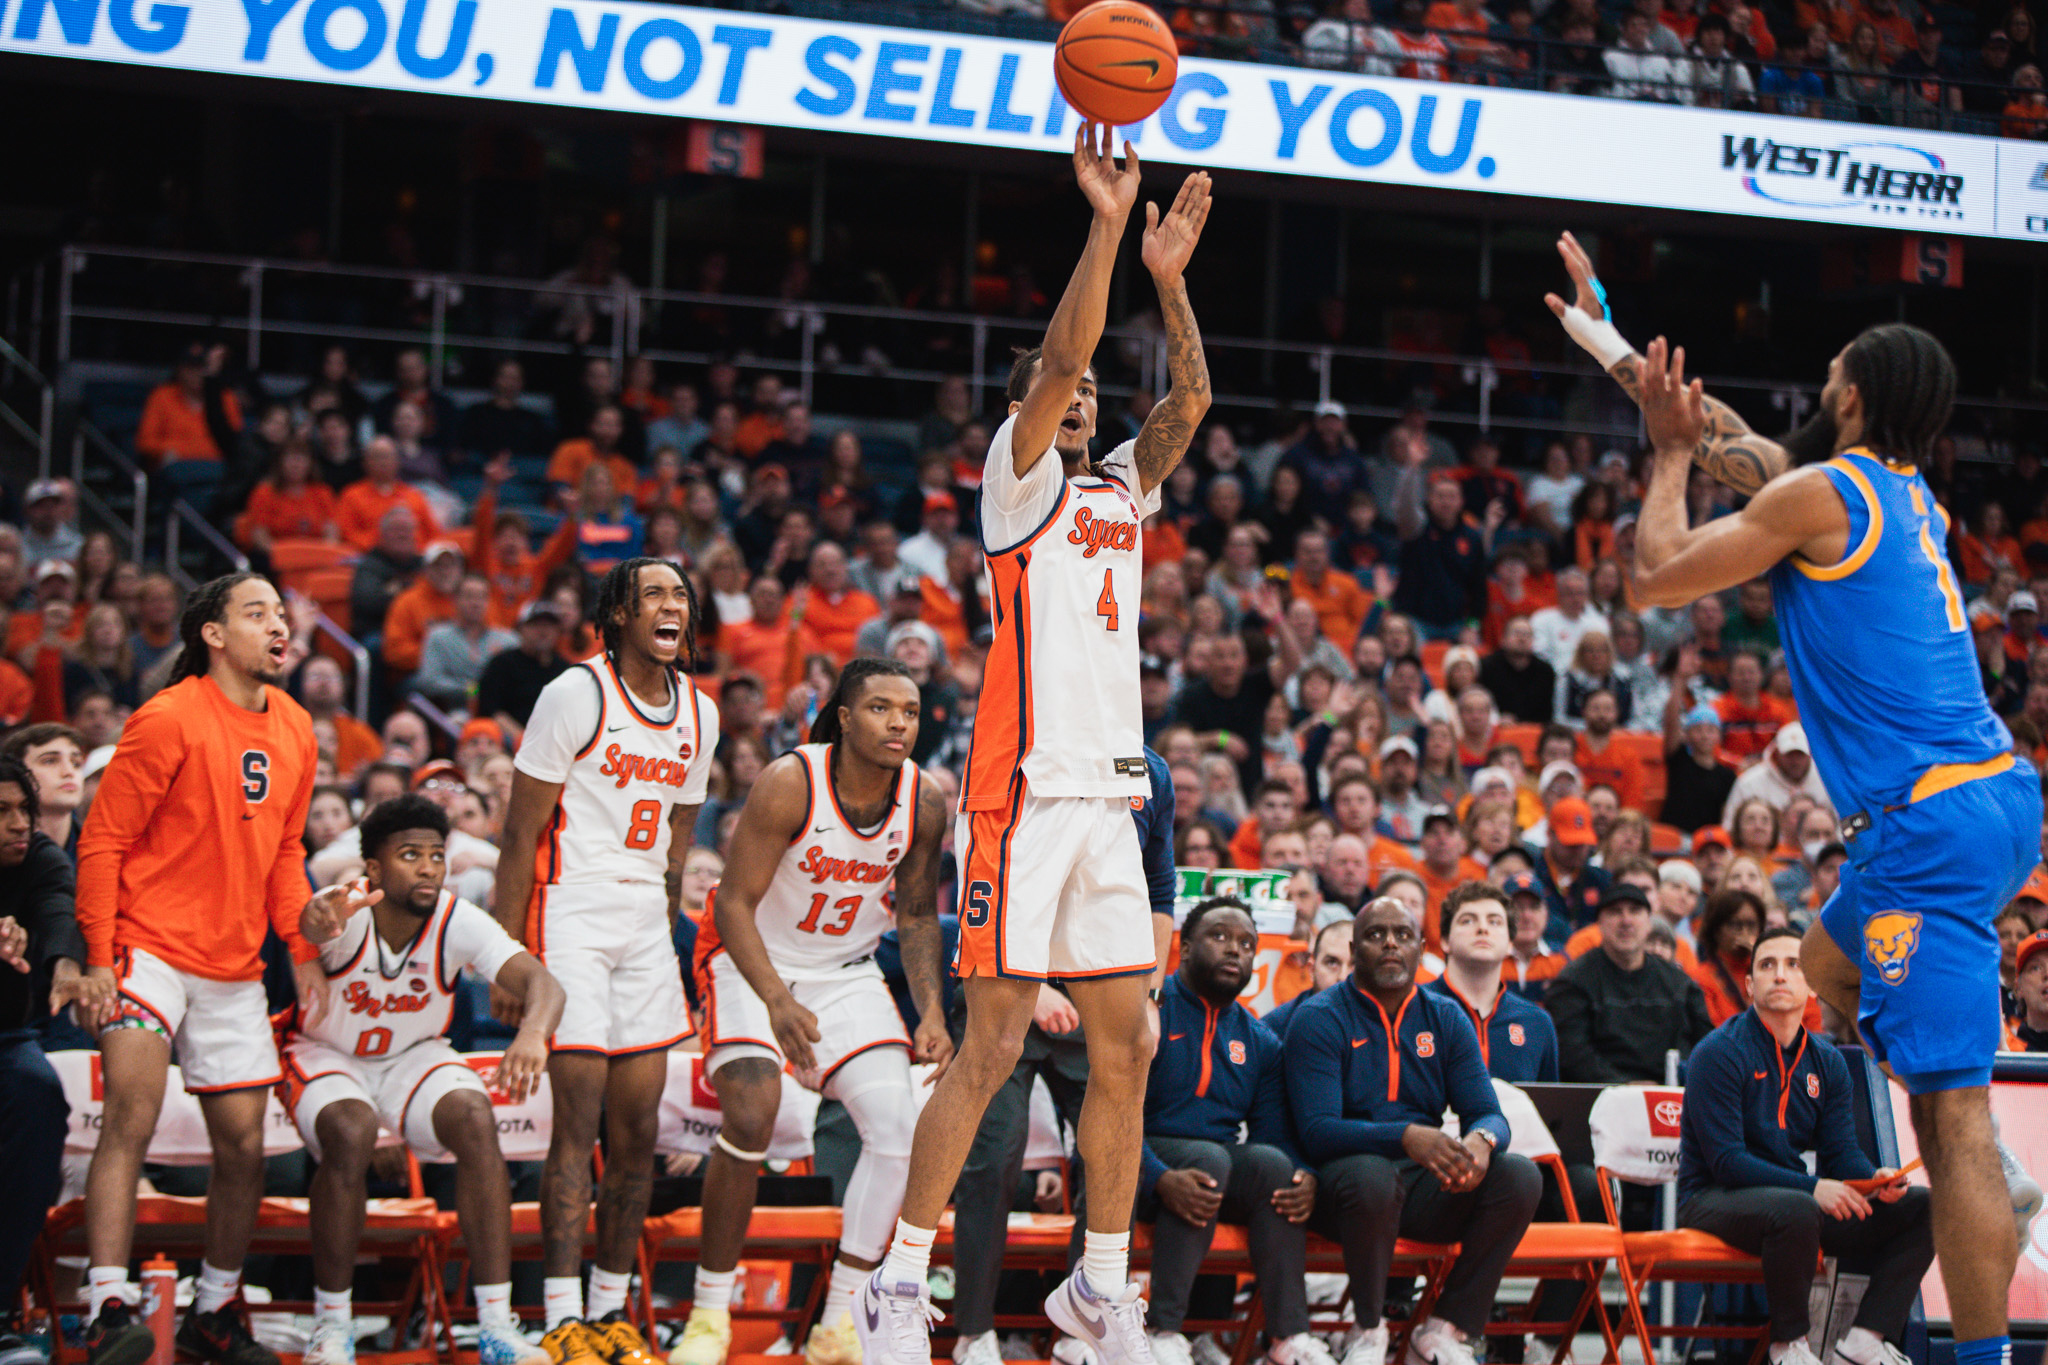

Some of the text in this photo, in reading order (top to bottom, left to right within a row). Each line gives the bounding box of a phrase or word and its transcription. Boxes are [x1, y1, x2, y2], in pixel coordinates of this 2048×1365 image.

[241, 0, 494, 87] YOU,
[534, 8, 774, 107] NOT
[794, 35, 1231, 152] SELLIG
[1267, 79, 1496, 179] YOU.
[1722, 134, 1964, 205] WEST HERR
[1067, 506, 1139, 559] Syracus
[1096, 567, 1119, 632] 4
[1919, 519, 1968, 633] 1
[241, 749, 271, 804] S
[600, 743, 690, 789] Syracus
[624, 799, 662, 851] 8
[798, 845, 898, 884] Syracus
[796, 892, 864, 937] 13
[966, 880, 994, 928] S
[353, 1026, 394, 1058] 0
[1228, 1039, 1246, 1066] S
[1415, 1031, 1435, 1058] S
[1507, 1023, 1526, 1047] S
[1806, 1072, 1820, 1099] S
